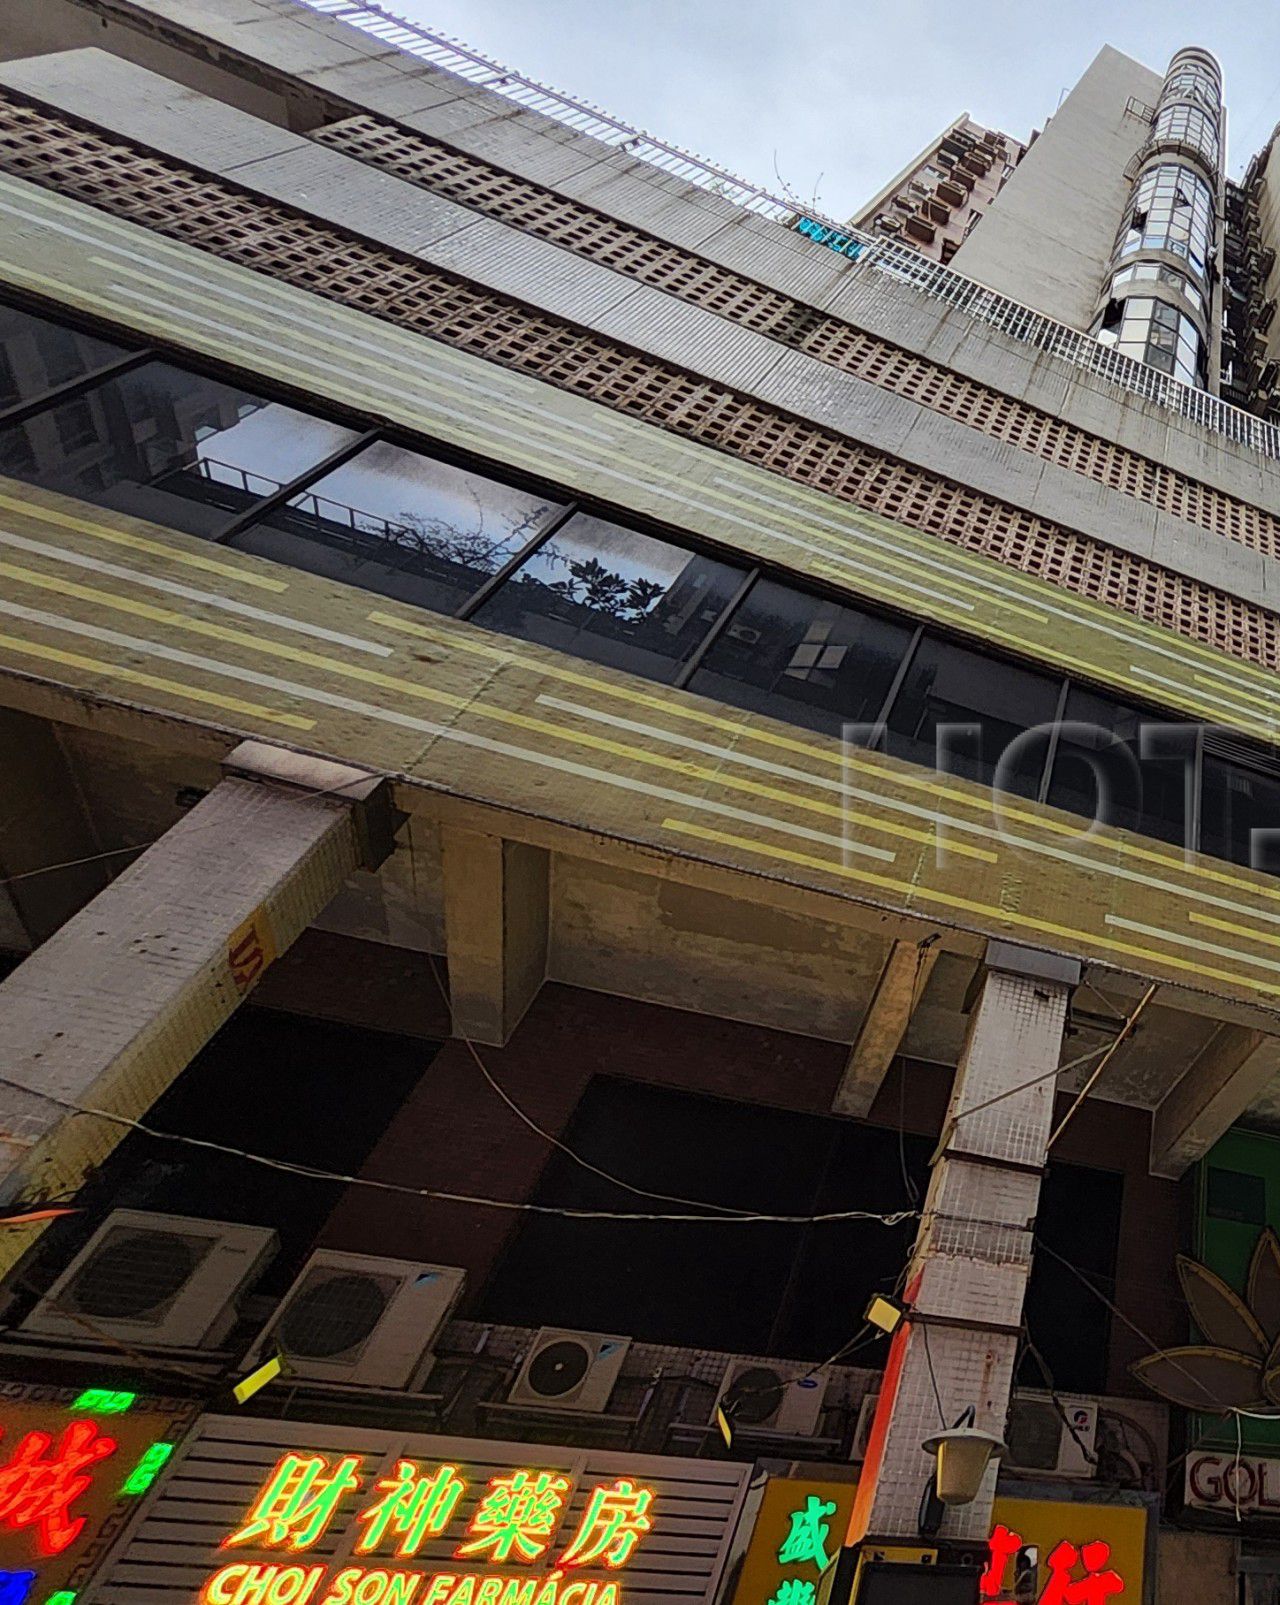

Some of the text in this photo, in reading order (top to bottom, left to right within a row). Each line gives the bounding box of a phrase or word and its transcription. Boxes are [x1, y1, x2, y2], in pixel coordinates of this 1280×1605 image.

[217, 1452, 656, 1570] 財神藥房
[206, 1563, 620, 1605] CHOI SON FARMÁCIA
